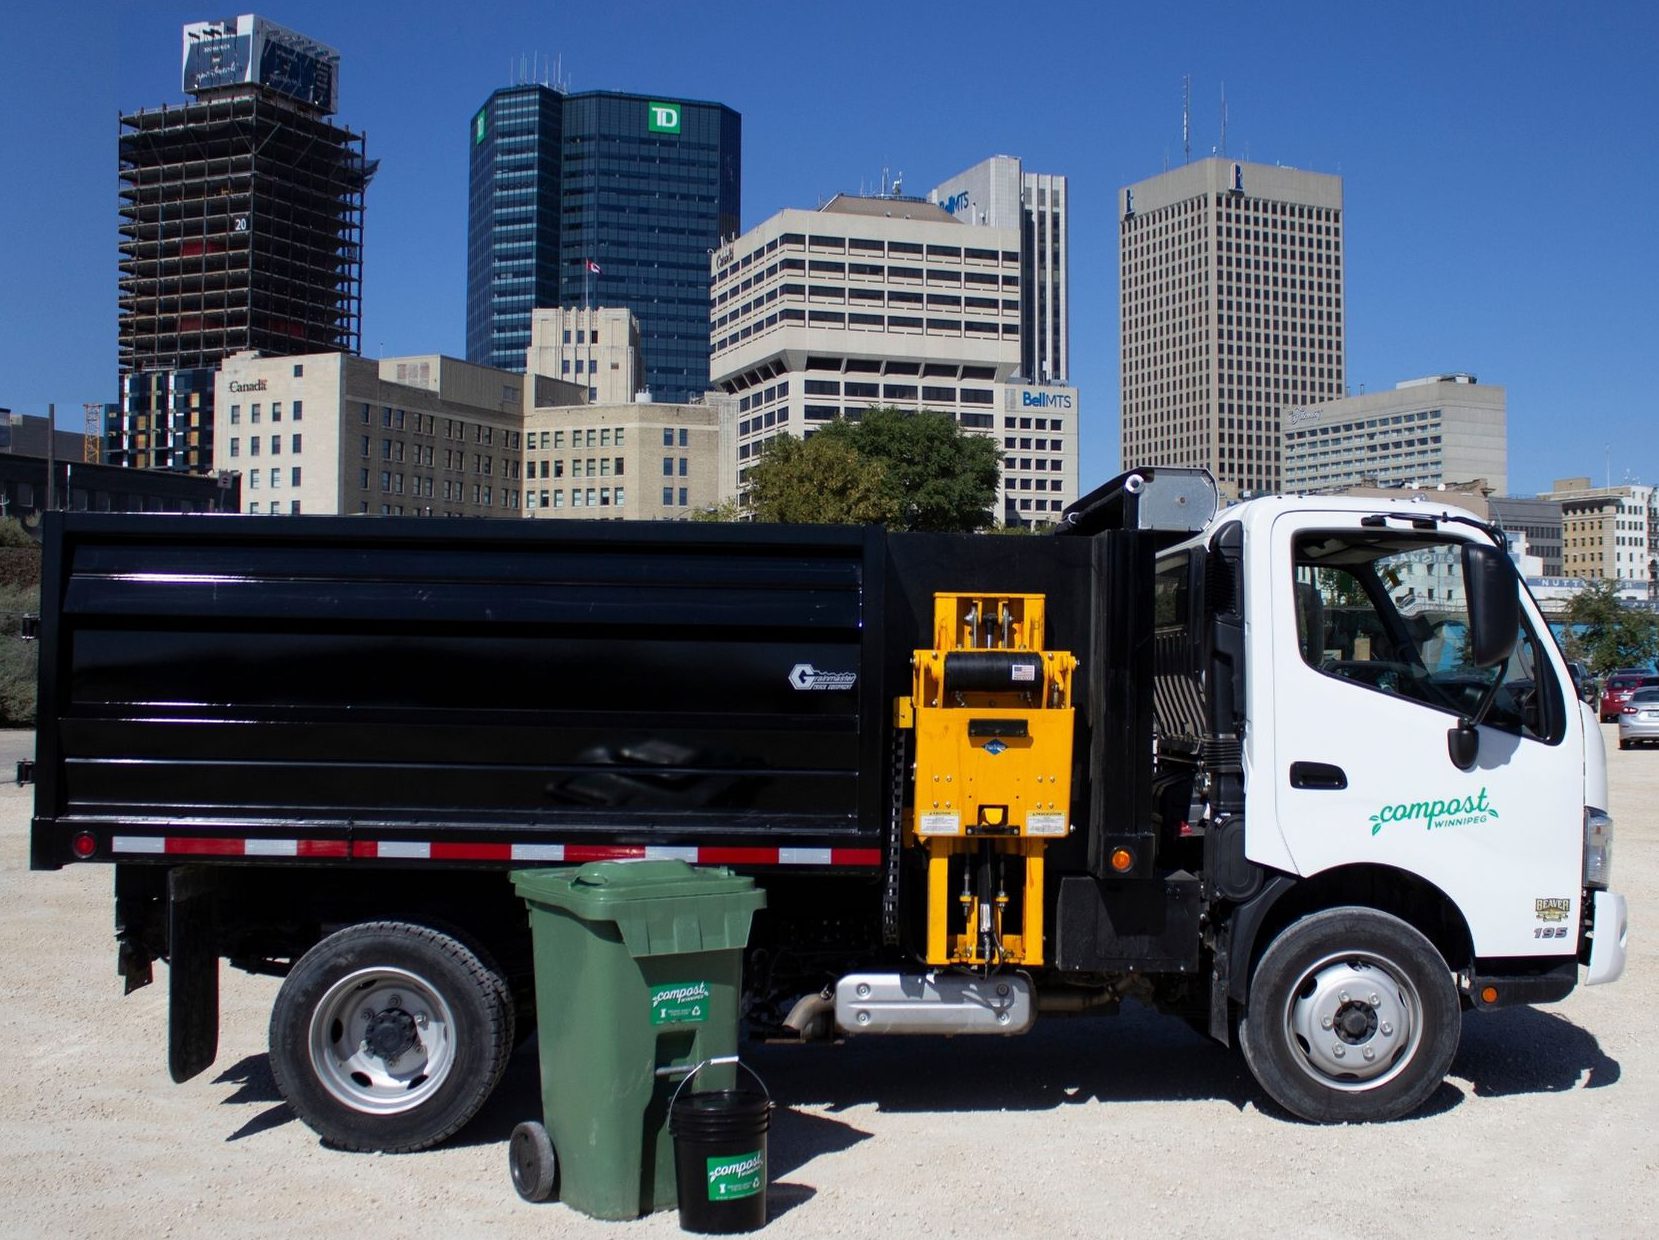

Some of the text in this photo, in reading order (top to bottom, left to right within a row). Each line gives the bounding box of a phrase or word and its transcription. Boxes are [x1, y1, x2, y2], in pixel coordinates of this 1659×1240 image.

[652, 107, 678, 127] TD
[235, 218, 247, 230] 20
[229, 379, 268, 393] Canada
[1380, 787, 1490, 830] compost
[1434, 815, 1488, 829] WINNIPEG
[1536, 898, 1570, 911] BEAVER
[1534, 927, 1568, 939] 195
[656, 981, 706, 1004] compost
[713, 1150, 764, 1179] compost
